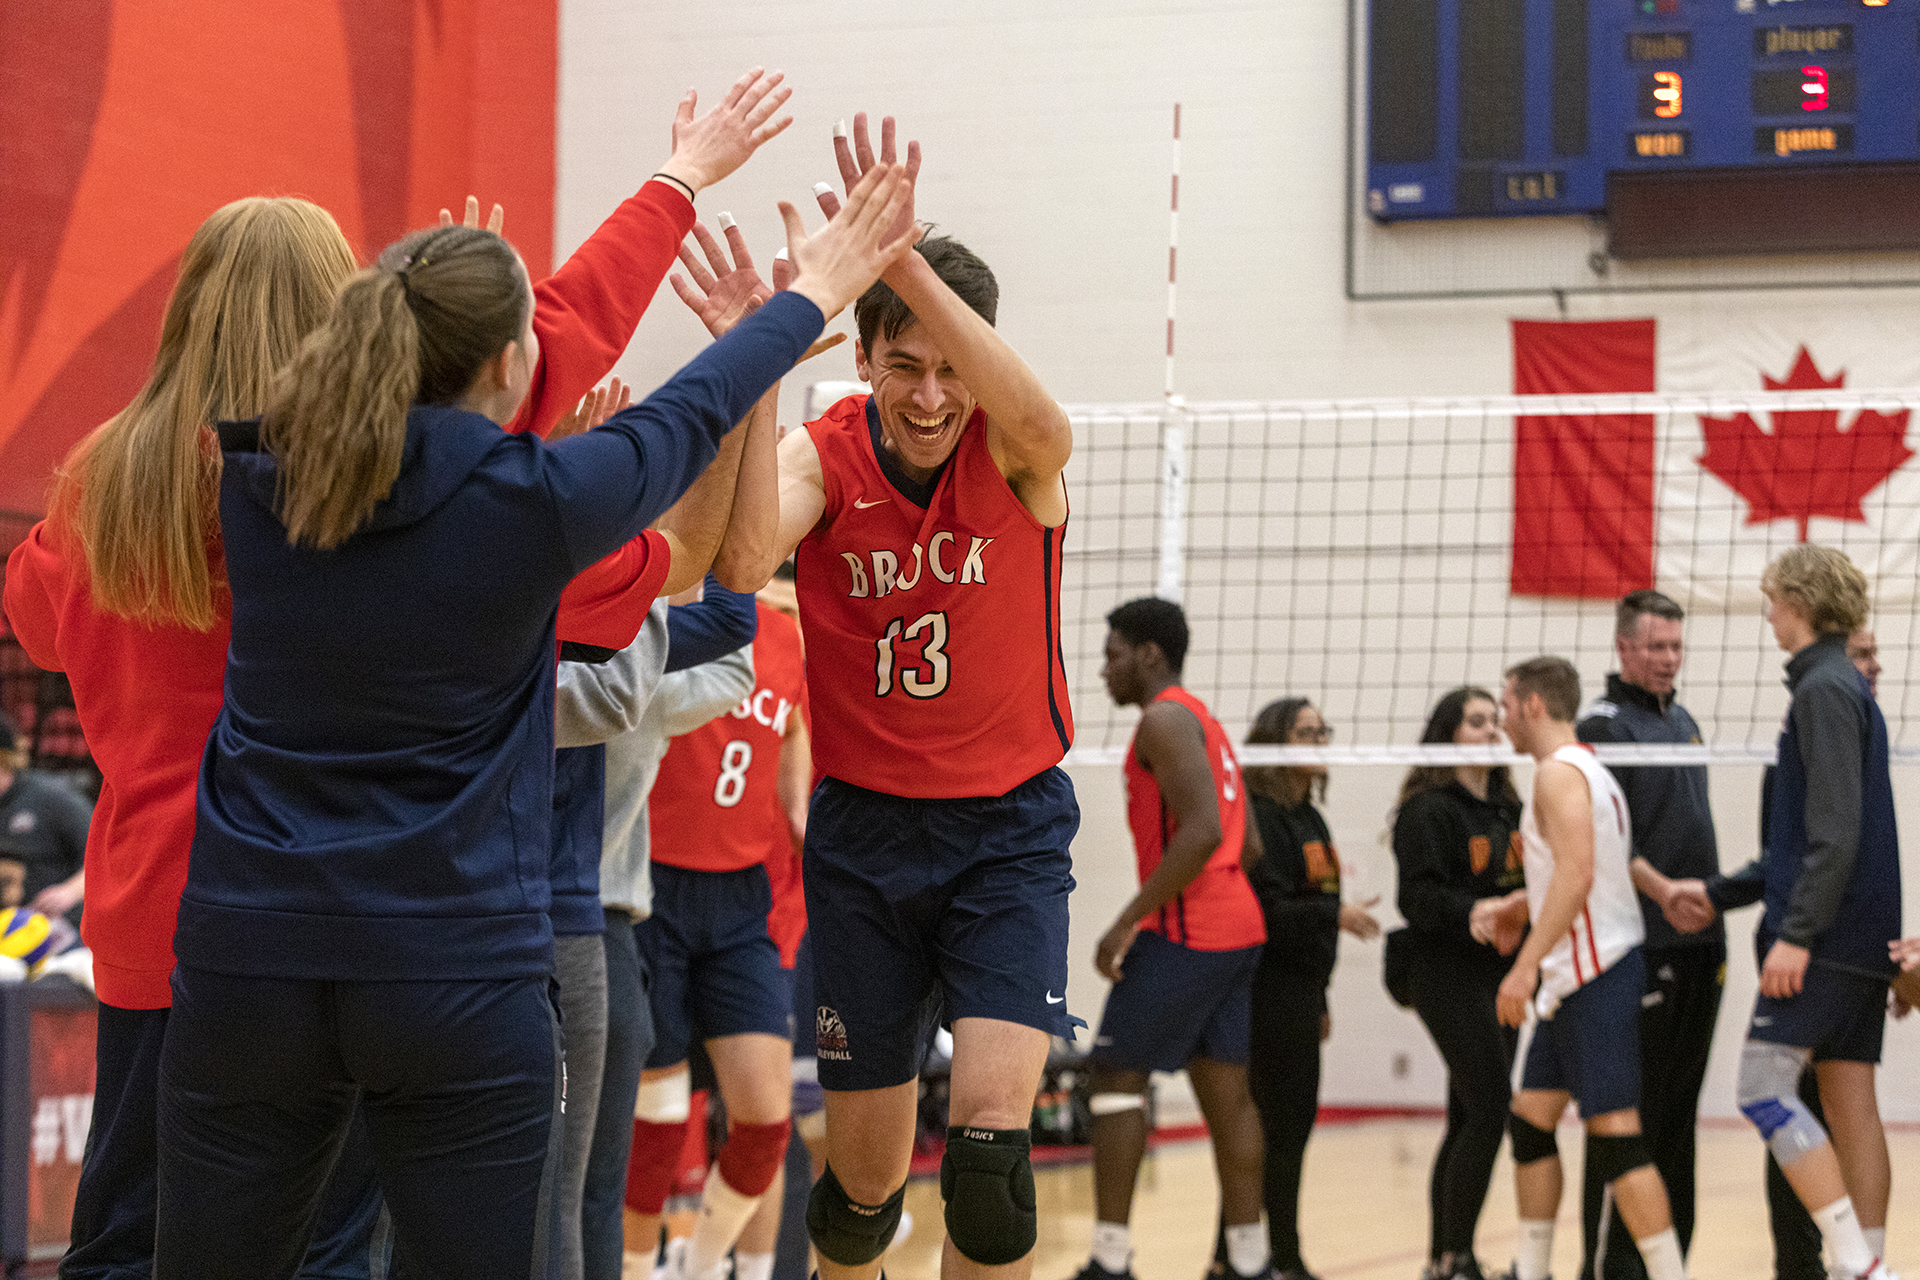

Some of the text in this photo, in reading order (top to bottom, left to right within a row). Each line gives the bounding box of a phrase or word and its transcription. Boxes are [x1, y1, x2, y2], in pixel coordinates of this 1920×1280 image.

[1654, 71, 1682, 117] 3
[1801, 66, 1828, 111] 3
[839, 531, 996, 598] BROCK
[875, 610, 951, 700] 13
[714, 740, 752, 807] 8
